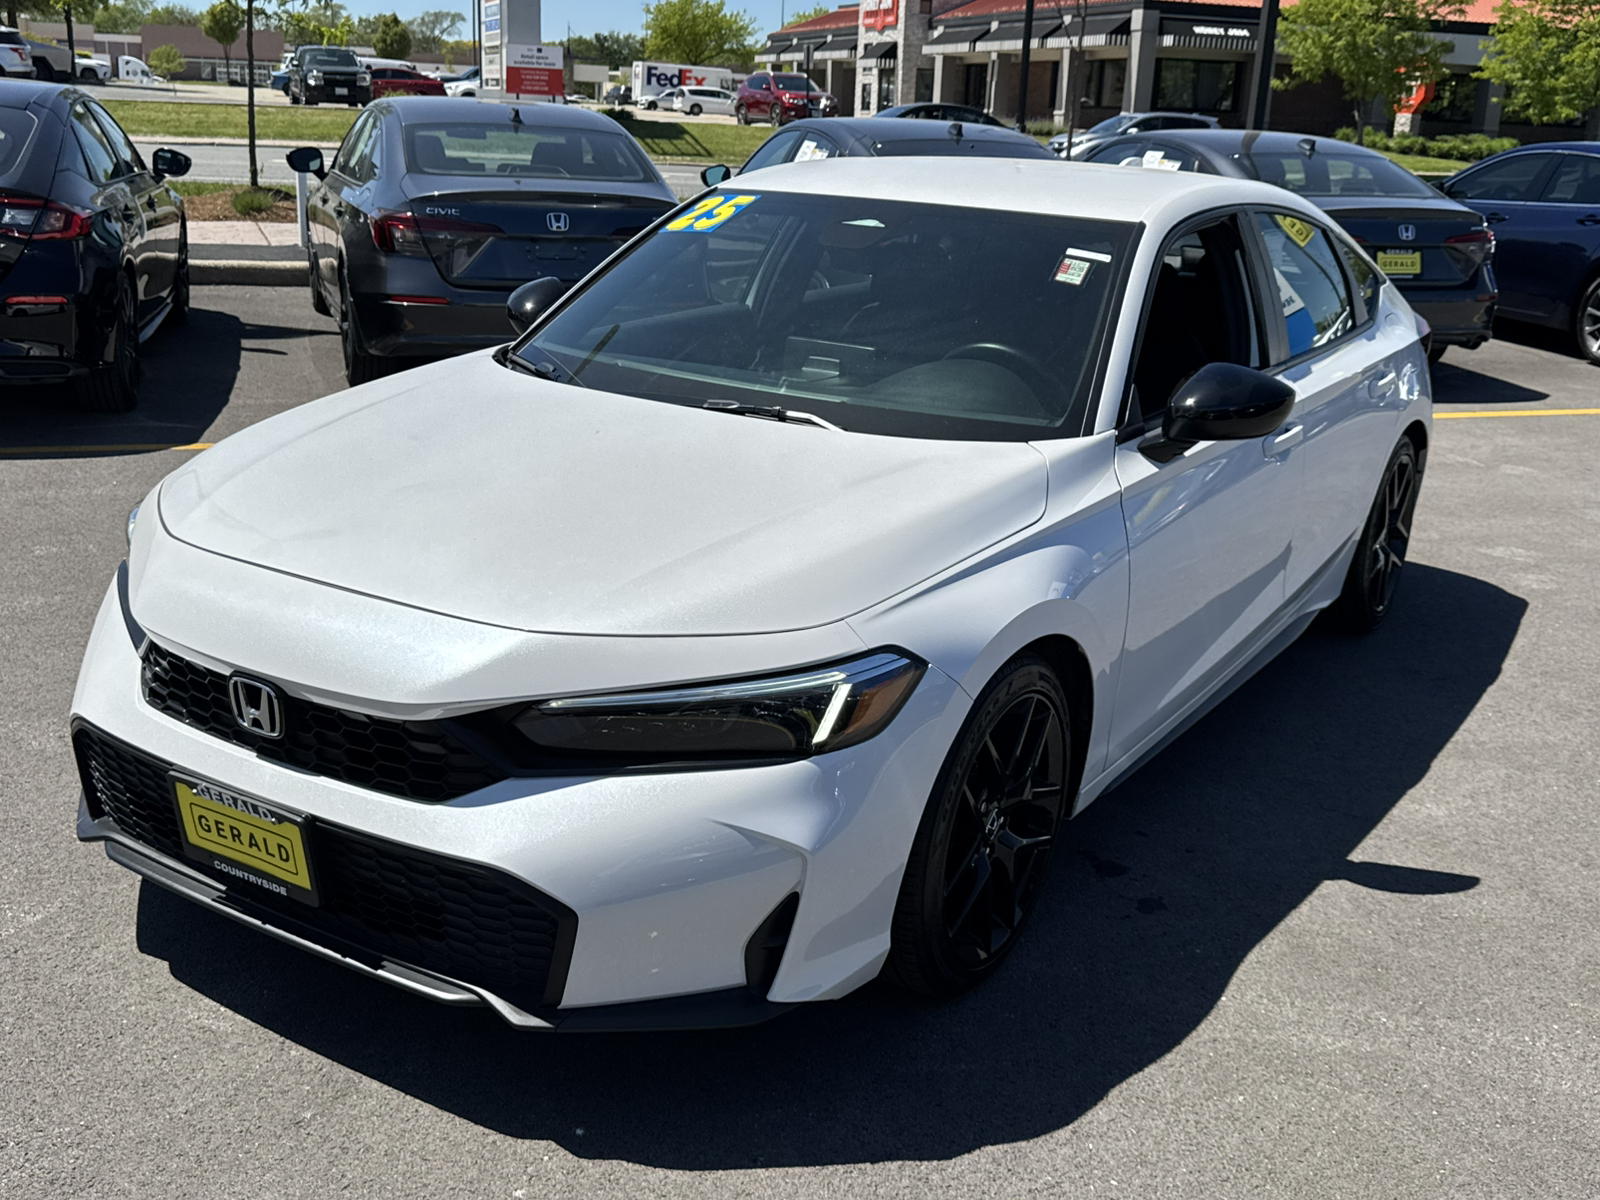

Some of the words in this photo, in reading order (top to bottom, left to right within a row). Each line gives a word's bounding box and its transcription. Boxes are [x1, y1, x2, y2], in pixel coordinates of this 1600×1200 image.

[647, 66, 707, 88] FedEx
[425, 207, 461, 216] CIVIC
[666, 195, 756, 231] 25
[198, 784, 273, 821] GERALD
[197, 814, 290, 863] GERALD
[213, 860, 288, 896] COUNTRYSIDE
